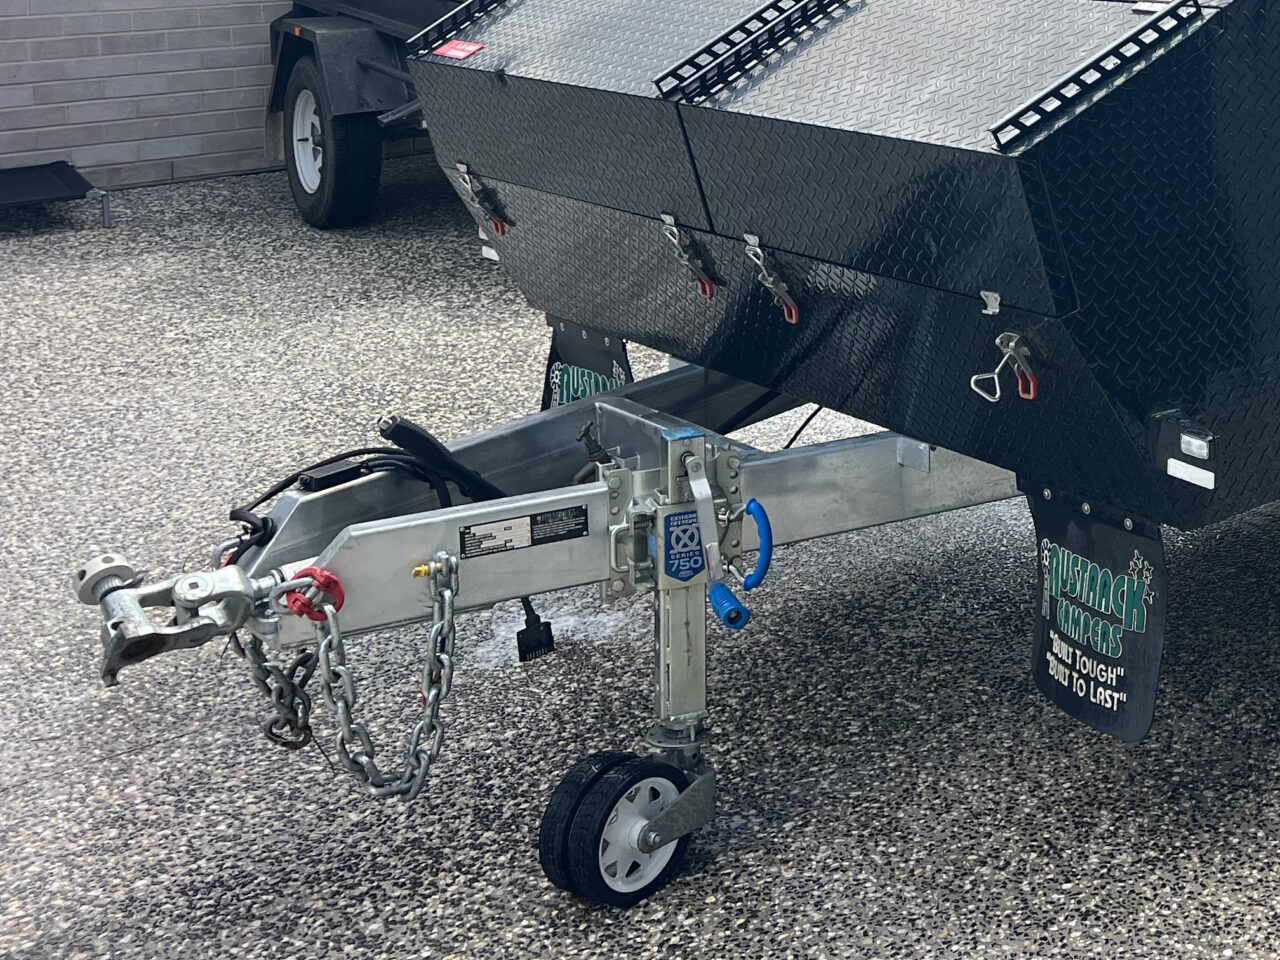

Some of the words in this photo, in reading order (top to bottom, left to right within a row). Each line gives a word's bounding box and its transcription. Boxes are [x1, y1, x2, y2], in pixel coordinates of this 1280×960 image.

[669, 556, 702, 572] 750
[670, 550, 701, 560] SERIES
[1050, 542, 1147, 633] AUSTRACK
[1056, 597, 1122, 659] CAMPERS
[1046, 651, 1069, 688] "BUILT
[1071, 674, 1087, 698] TO
[1089, 681, 1127, 712] LAST"
[1050, 630, 1073, 666] "BUILT
[1075, 649, 1125, 687] TOUGH"
